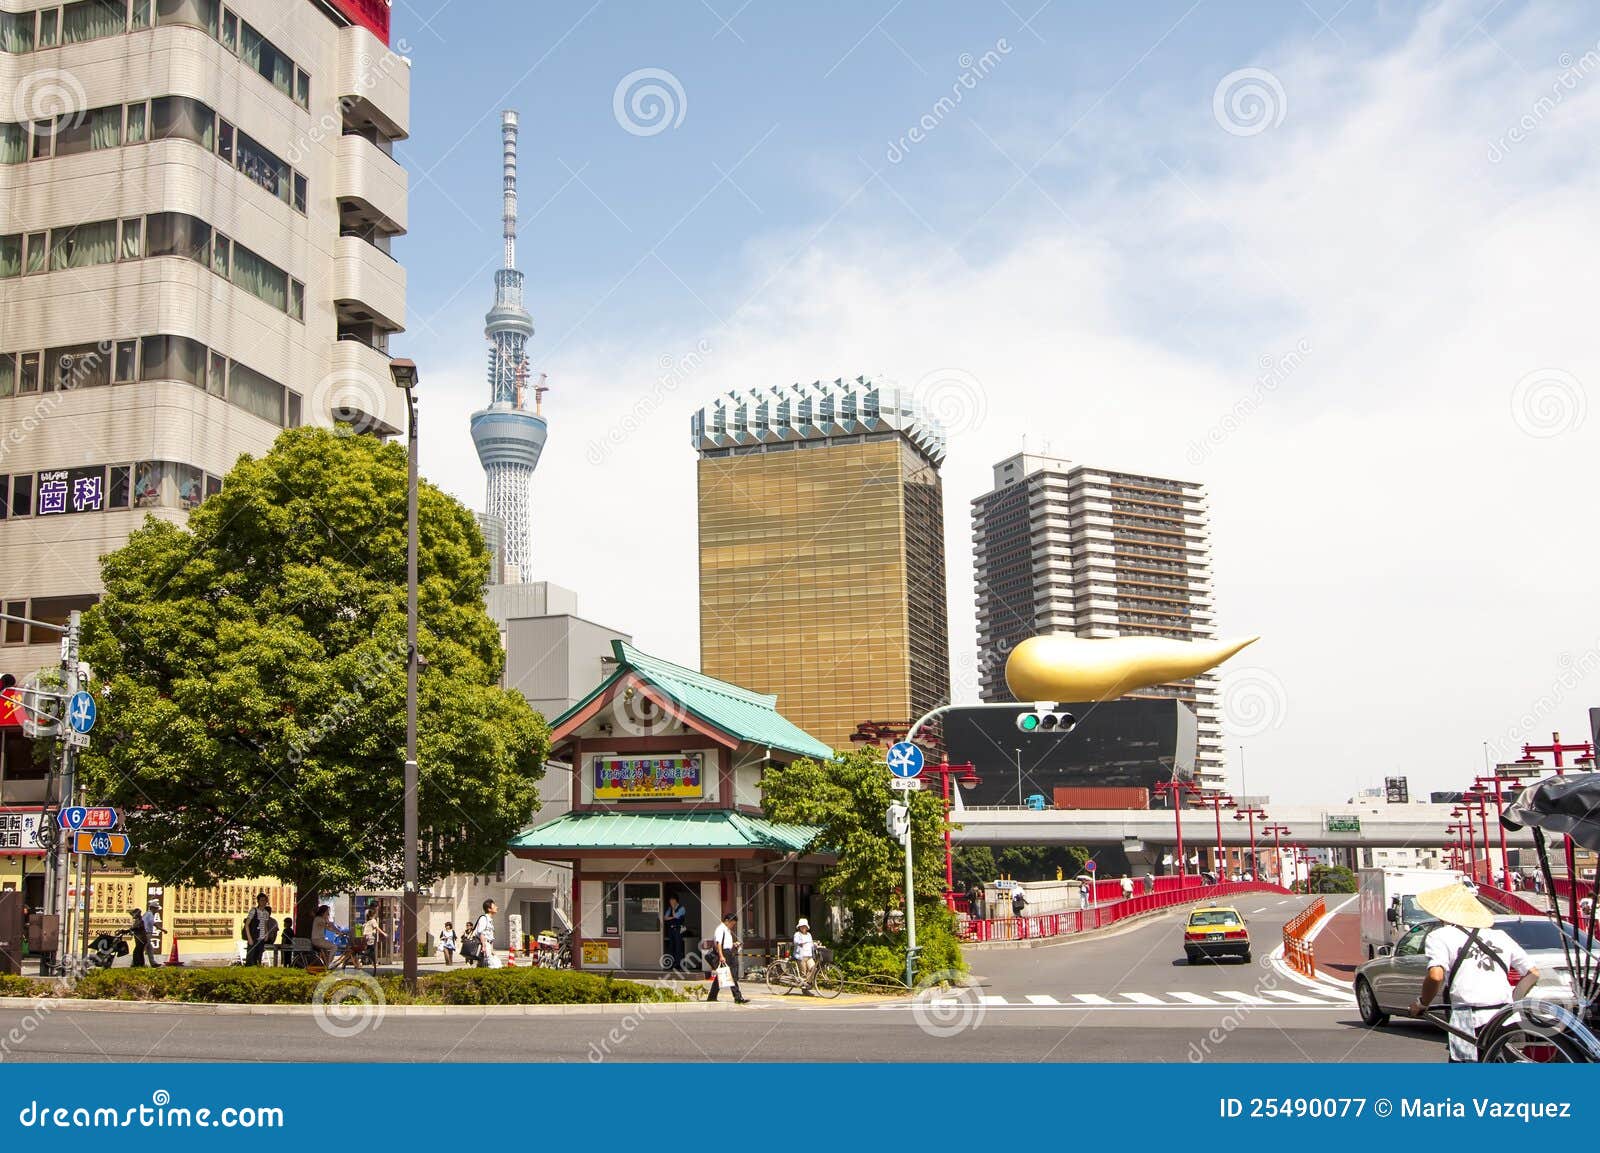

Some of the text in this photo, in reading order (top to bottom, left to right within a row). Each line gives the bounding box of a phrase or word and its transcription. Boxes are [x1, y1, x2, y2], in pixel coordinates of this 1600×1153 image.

[40, 477, 102, 514] 歯科
[71, 810, 81, 823] 6
[92, 837, 108, 850] 463
